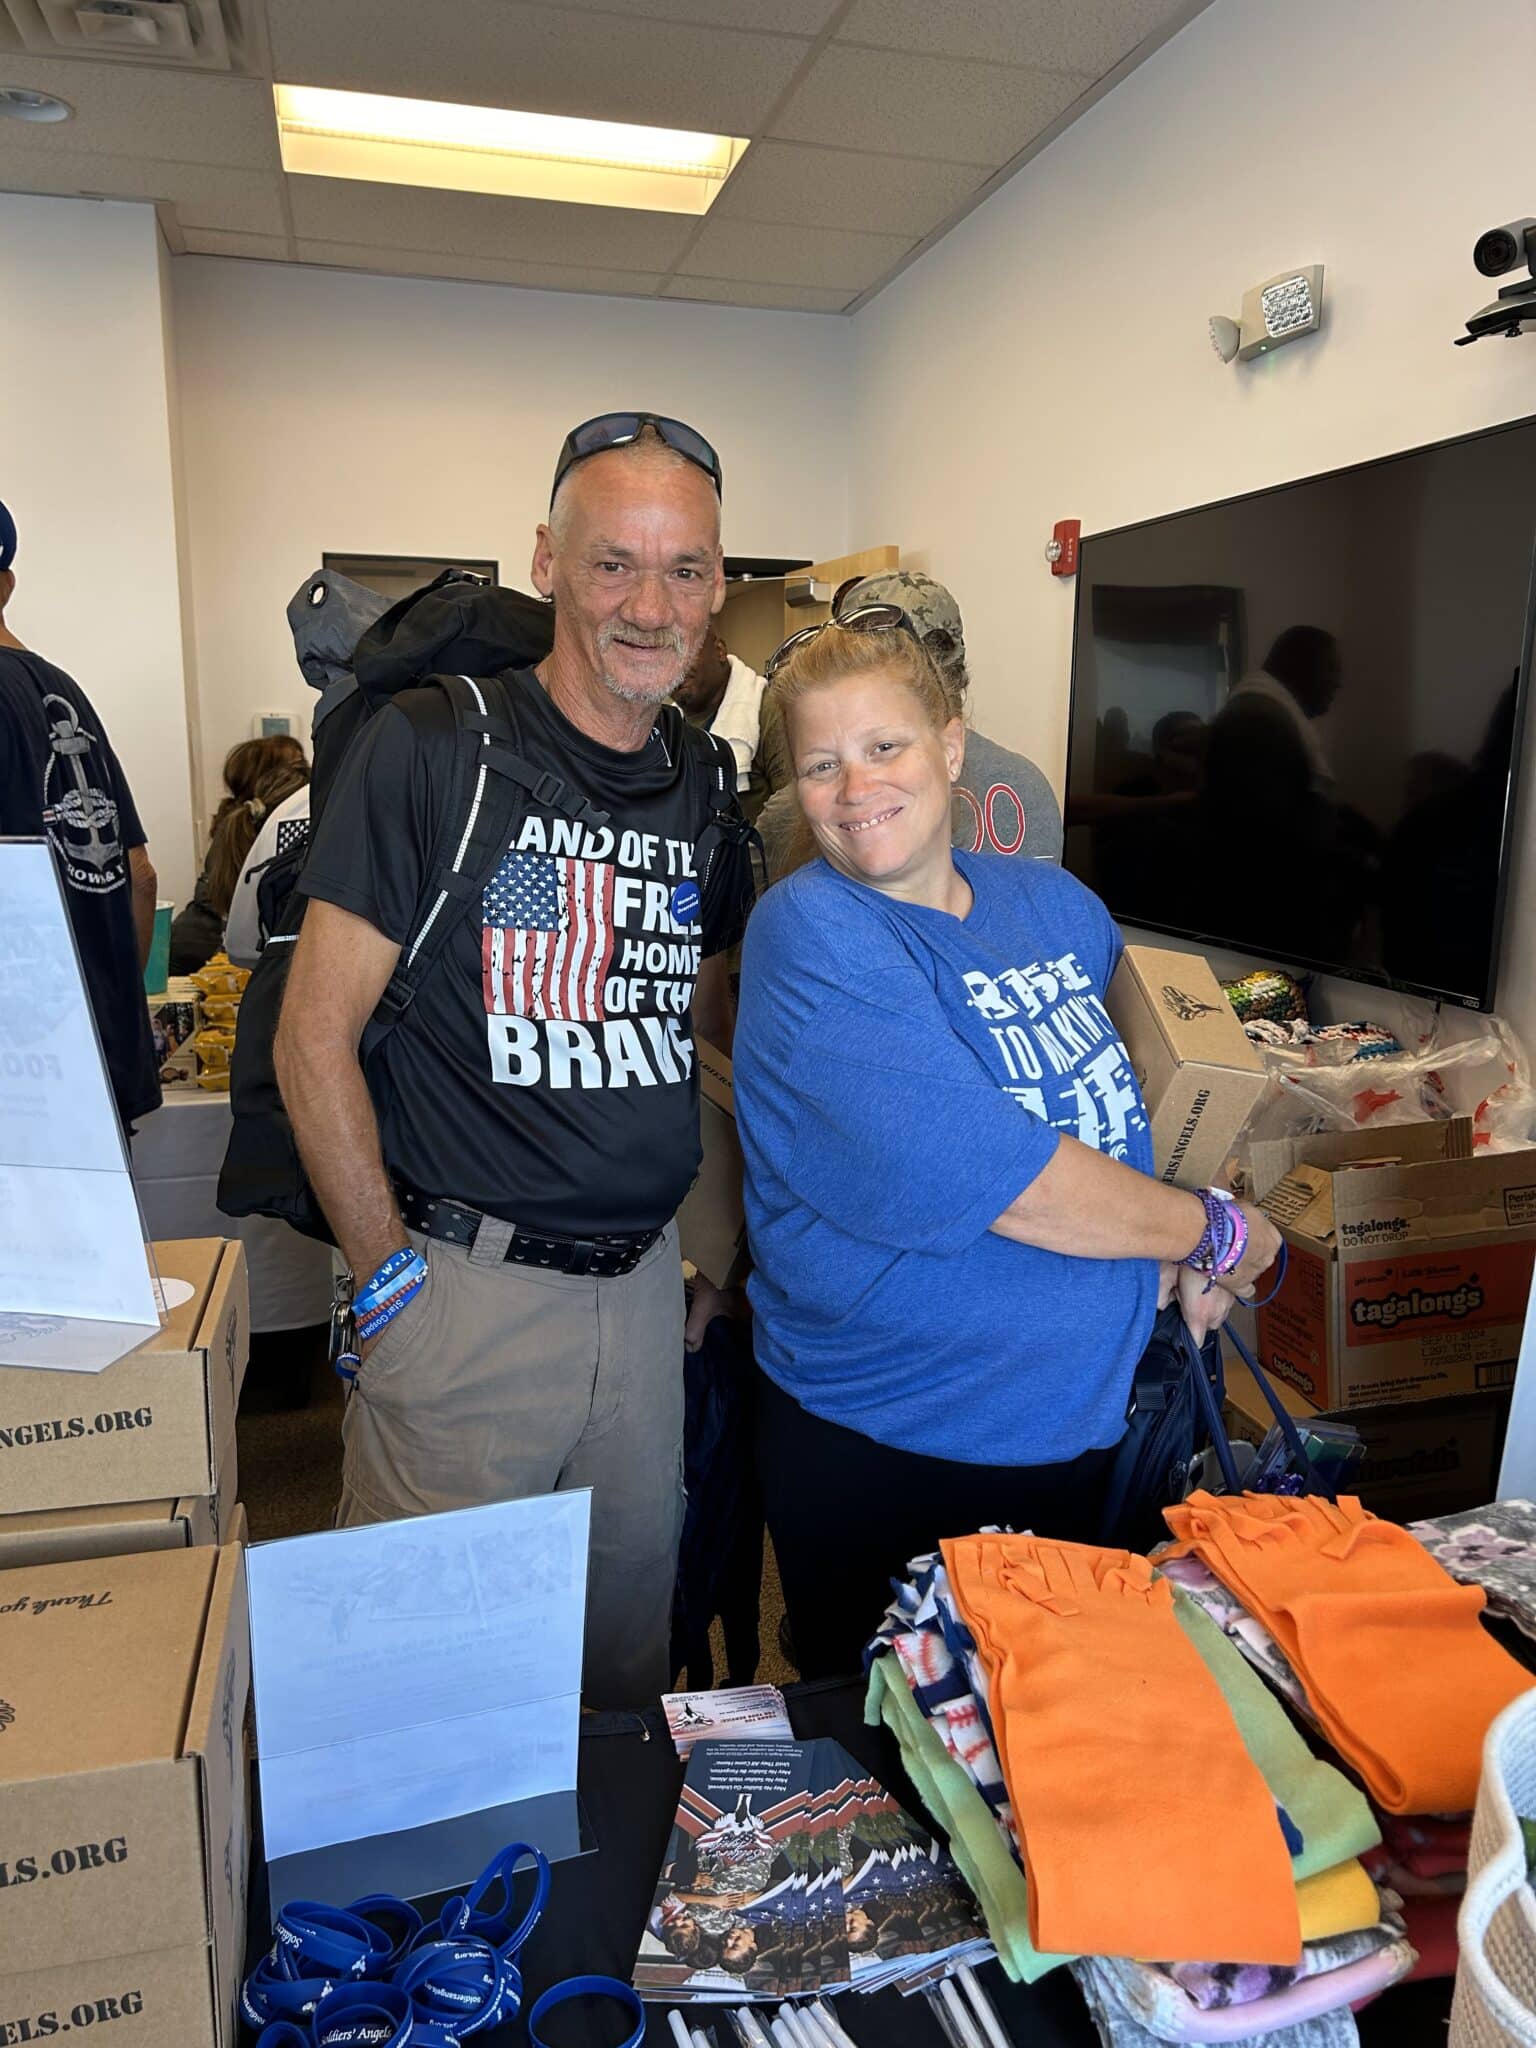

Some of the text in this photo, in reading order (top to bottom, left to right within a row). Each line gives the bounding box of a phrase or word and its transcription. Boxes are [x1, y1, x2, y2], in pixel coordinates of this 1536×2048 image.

[509, 815, 615, 860] AND
[618, 830, 660, 870] OF
[604, 976, 697, 1014] OF TH
[1352, 1286, 1483, 1327] tagalongs
[32, 1591, 112, 1615] Thank
